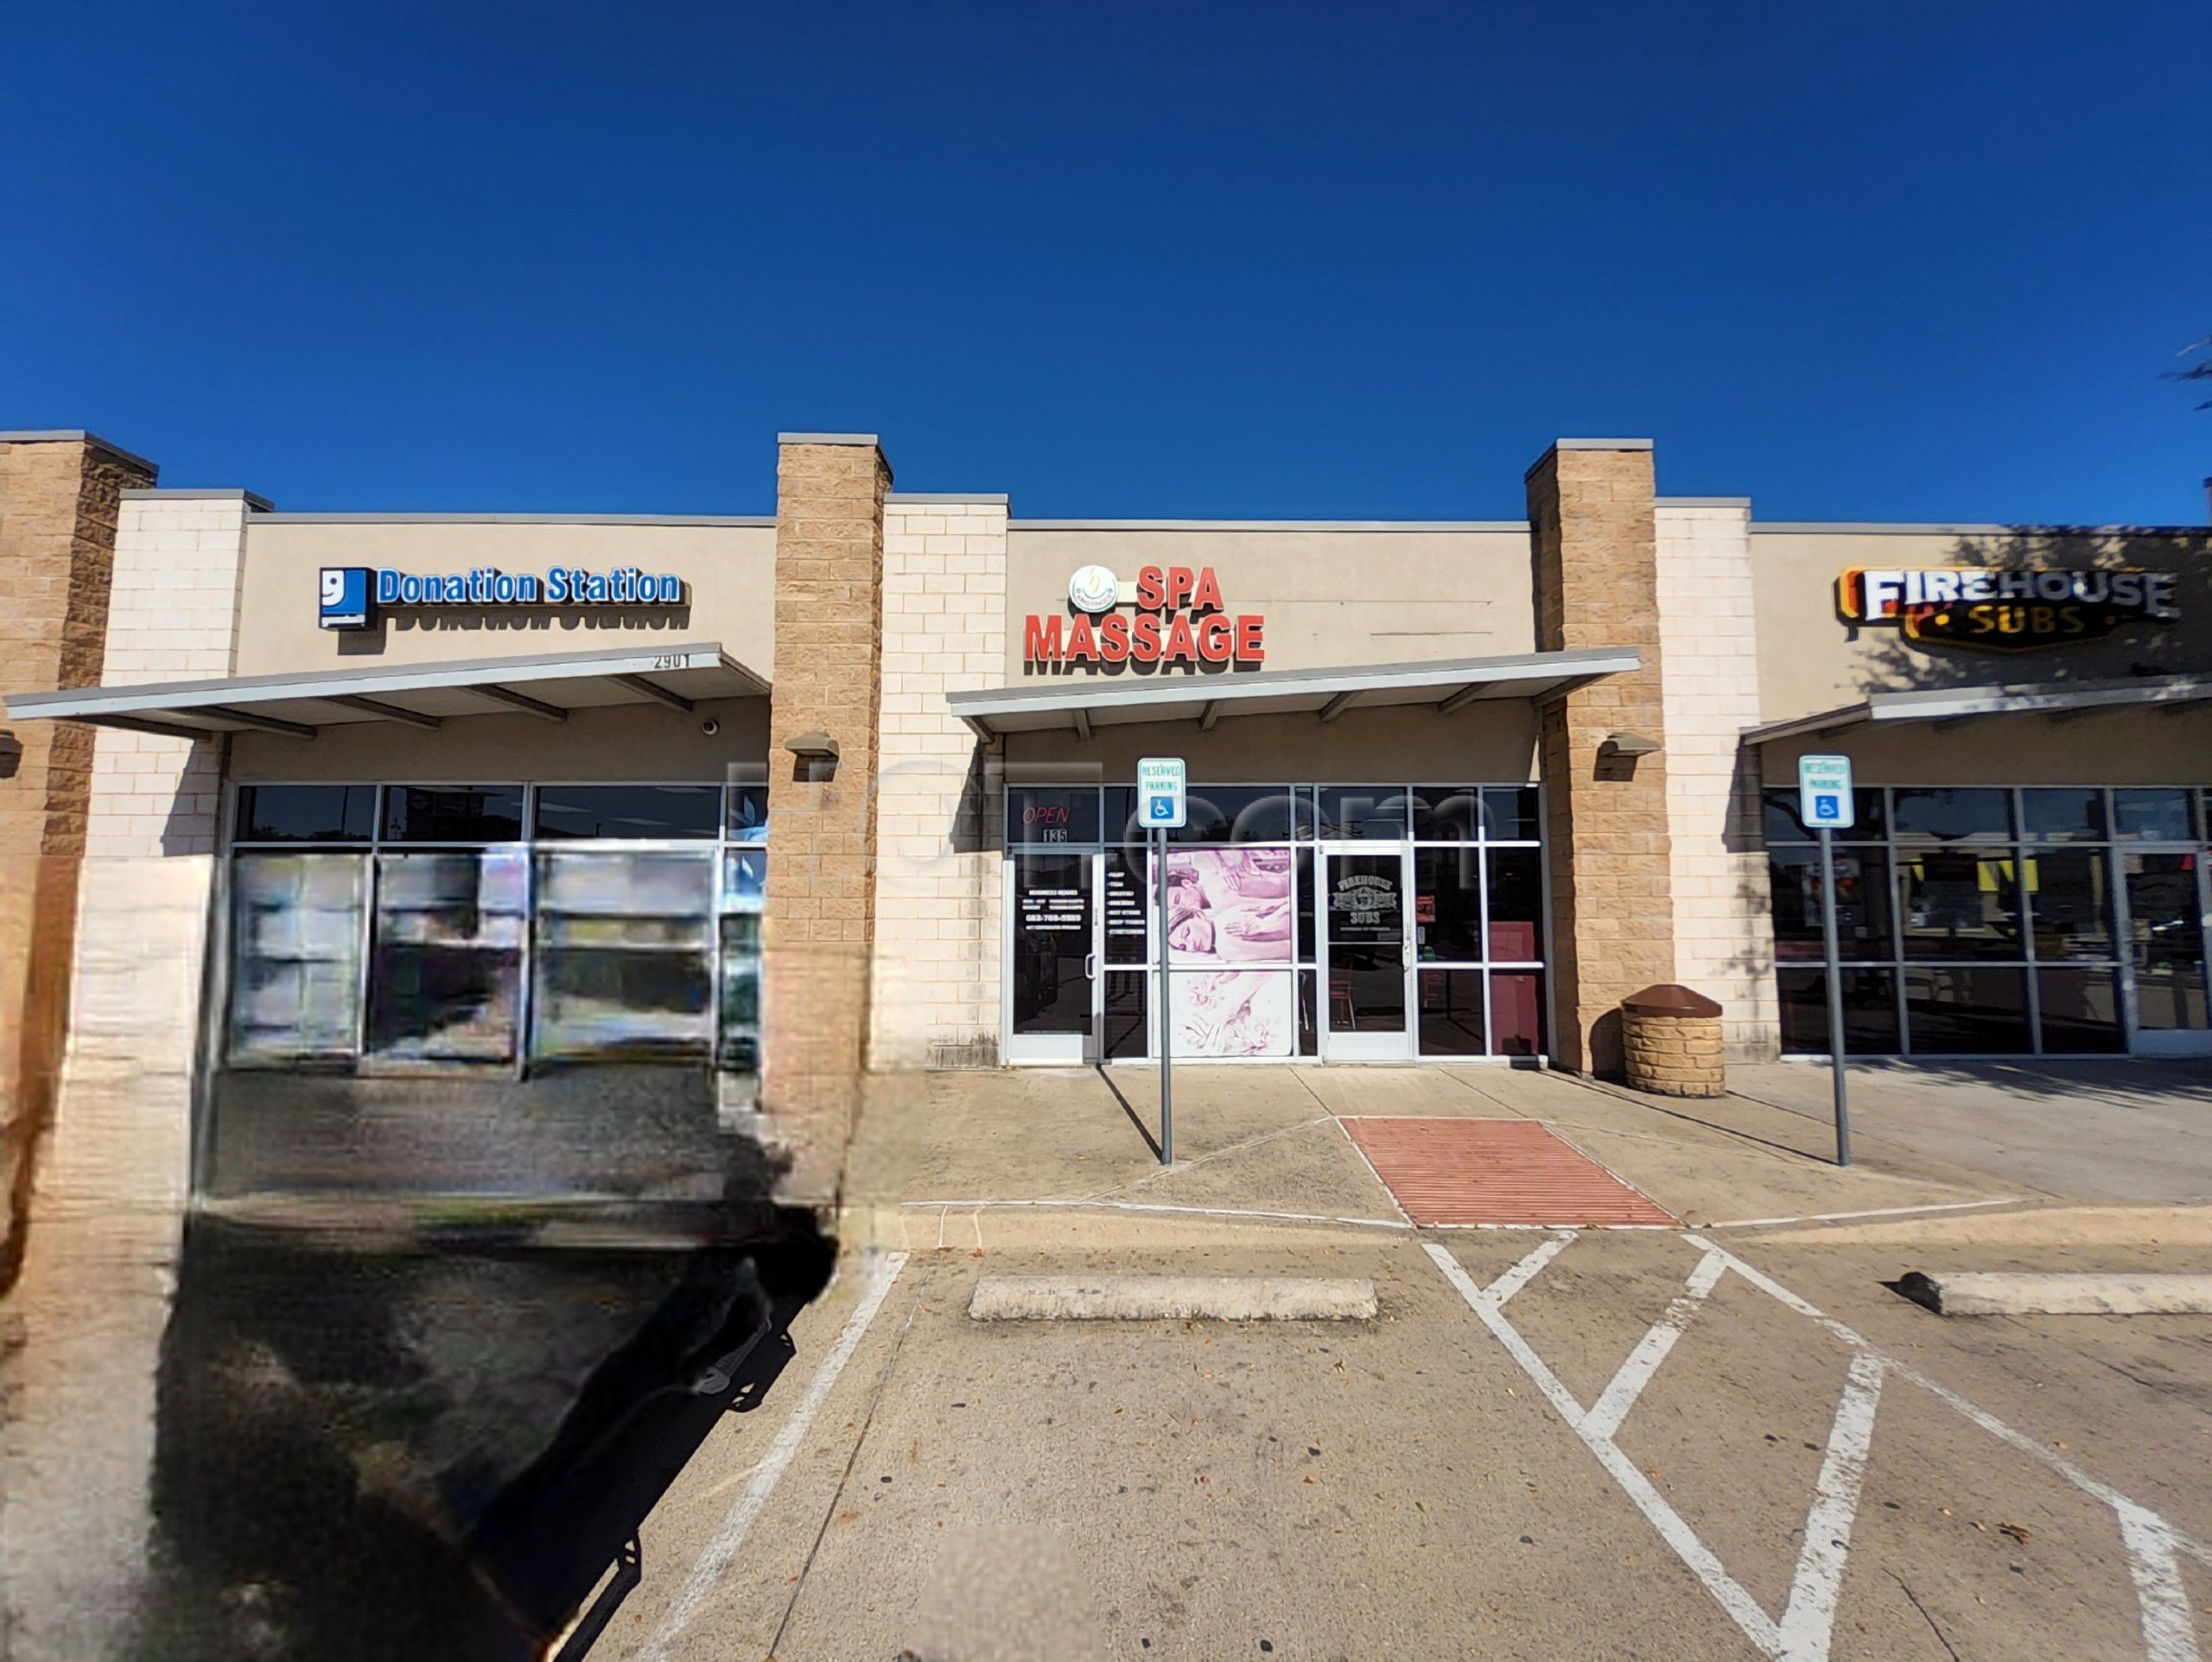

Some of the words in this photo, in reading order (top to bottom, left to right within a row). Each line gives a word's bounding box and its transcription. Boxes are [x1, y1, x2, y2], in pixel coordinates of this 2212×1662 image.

[377, 566, 538, 604] Donation
[546, 566, 681, 604] Station
[1137, 565, 1225, 610] SPA
[1862, 570, 2182, 621] FIREHOUSE
[1968, 605, 2085, 634] SUBS
[1024, 614, 1266, 663] MASSAGE
[654, 653, 690, 669] 2901
[1146, 780, 1179, 792] PARKING
[1022, 806, 1071, 825] OPEN
[1044, 830, 1068, 843] 135
[1350, 911, 1381, 925] SUBS
